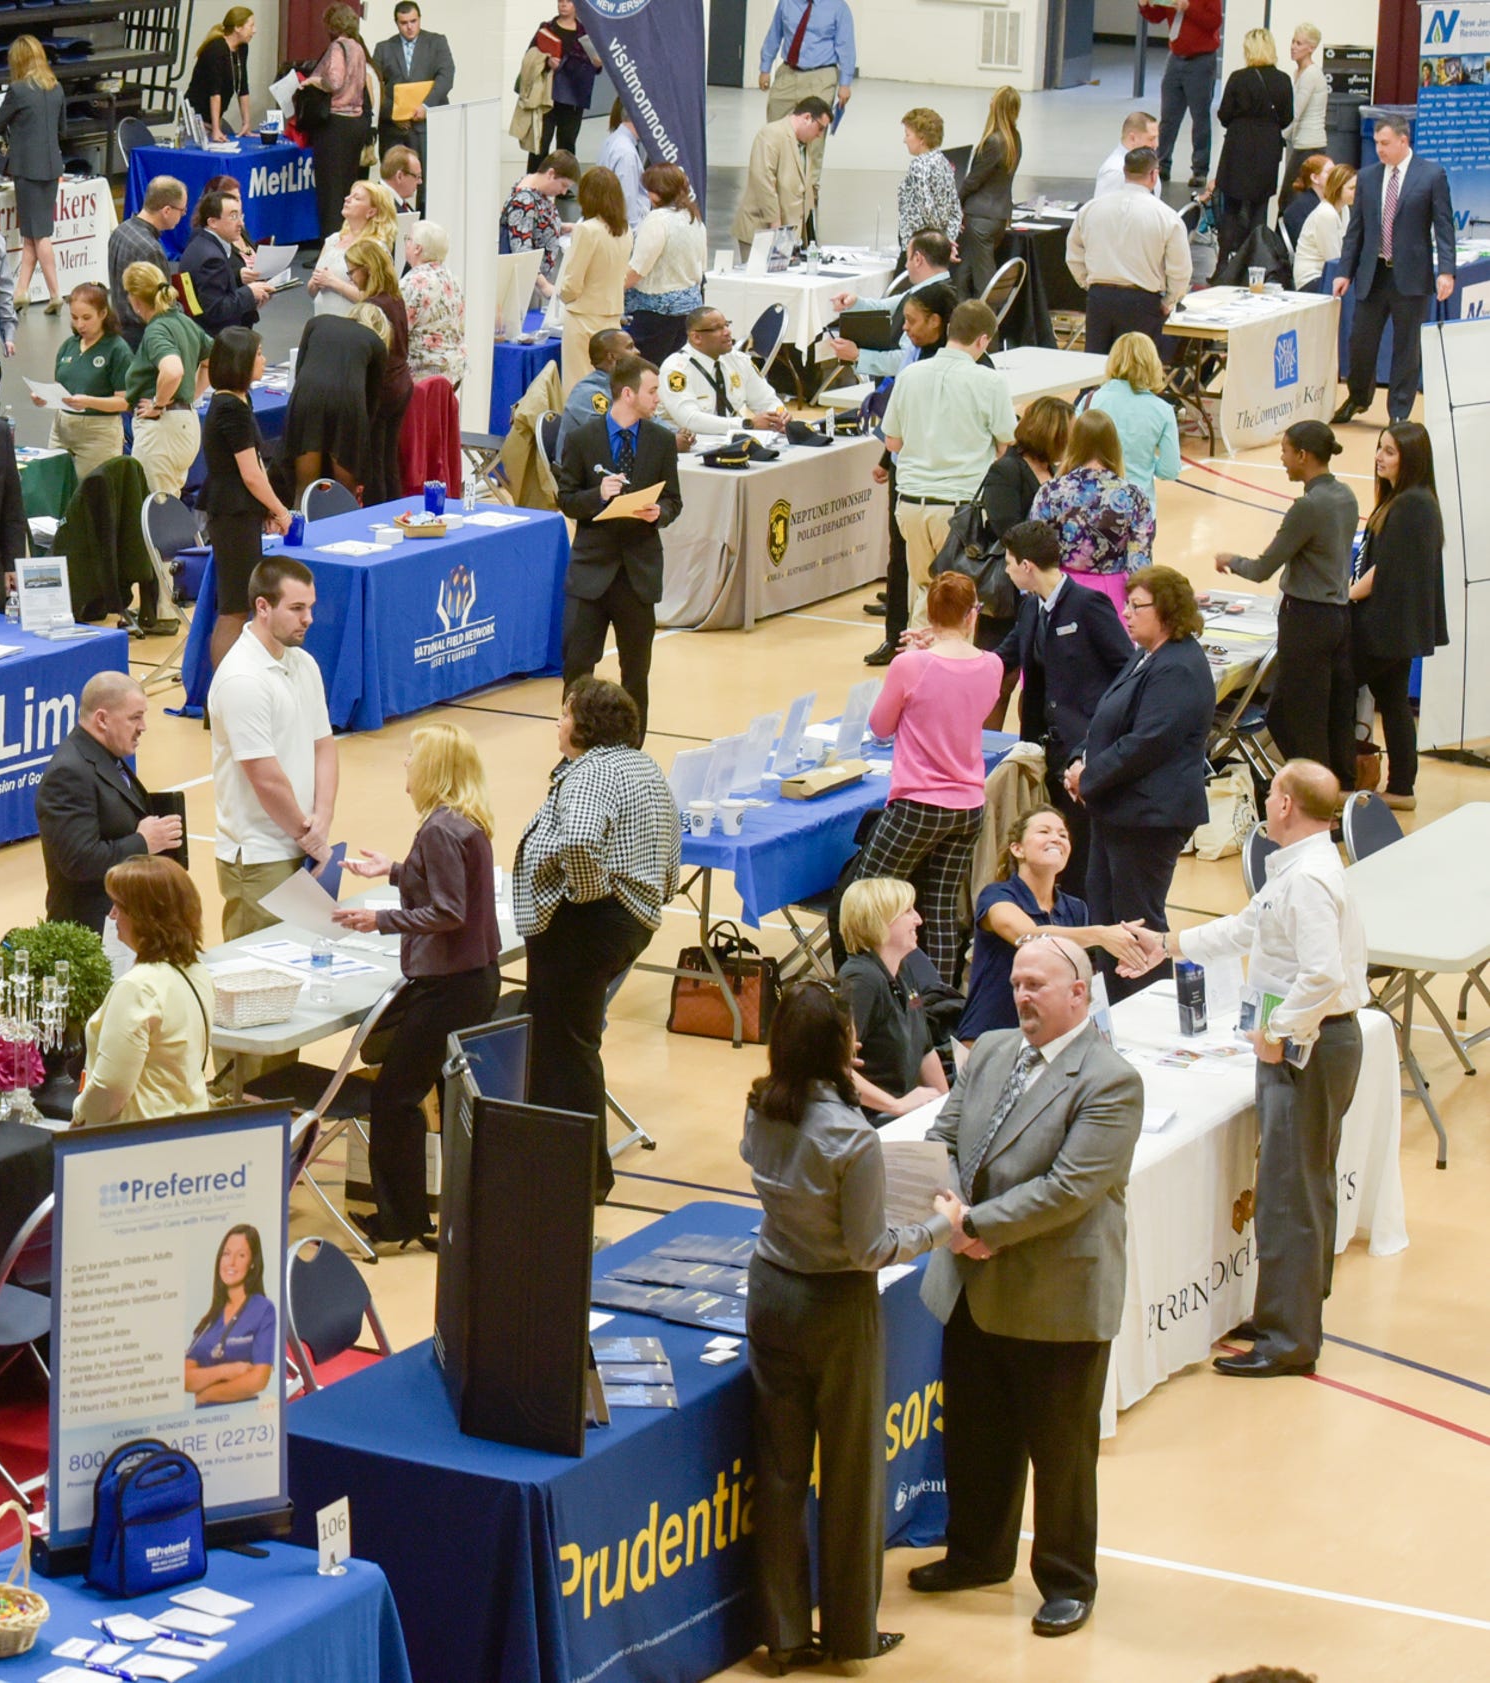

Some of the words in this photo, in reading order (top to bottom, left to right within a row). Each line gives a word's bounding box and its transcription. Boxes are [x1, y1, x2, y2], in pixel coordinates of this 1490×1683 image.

[1461, 28, 1490, 37] Resourc
[1478, 18, 1490, 27] Jer
[1276, 348, 1296, 364] YORK
[1278, 337, 1294, 352] NEW
[1279, 365, 1295, 381] LIFE
[1236, 410, 1253, 430] The
[1255, 401, 1293, 425] Company
[790, 503, 829, 526] NEPTUNE
[831, 488, 872, 513] TOWNSHIP
[797, 525, 822, 542] POLICE
[823, 510, 866, 535] DEPARTMENT
[415, 639, 445, 659] NATIONAL
[446, 633, 464, 648] FIELD
[465, 622, 495, 643] NETWORK
[18, 775, 26, 791] of
[28, 769, 44, 785] Go
[131, 1164, 246, 1202] Preferred
[152, 1200, 172, 1210] Care
[112, 1428, 151, 1439] LICENSED
[157, 1419, 190, 1432] BONDED
[196, 1413, 230, 1426] INSURED
[69, 1450, 105, 1472] 800
[215, 1424, 275, 1451] (2273)
[908, 1477, 947, 1501] Prudent
[321, 1512, 346, 1541] 106
[559, 1459, 756, 1620] Prudentia
